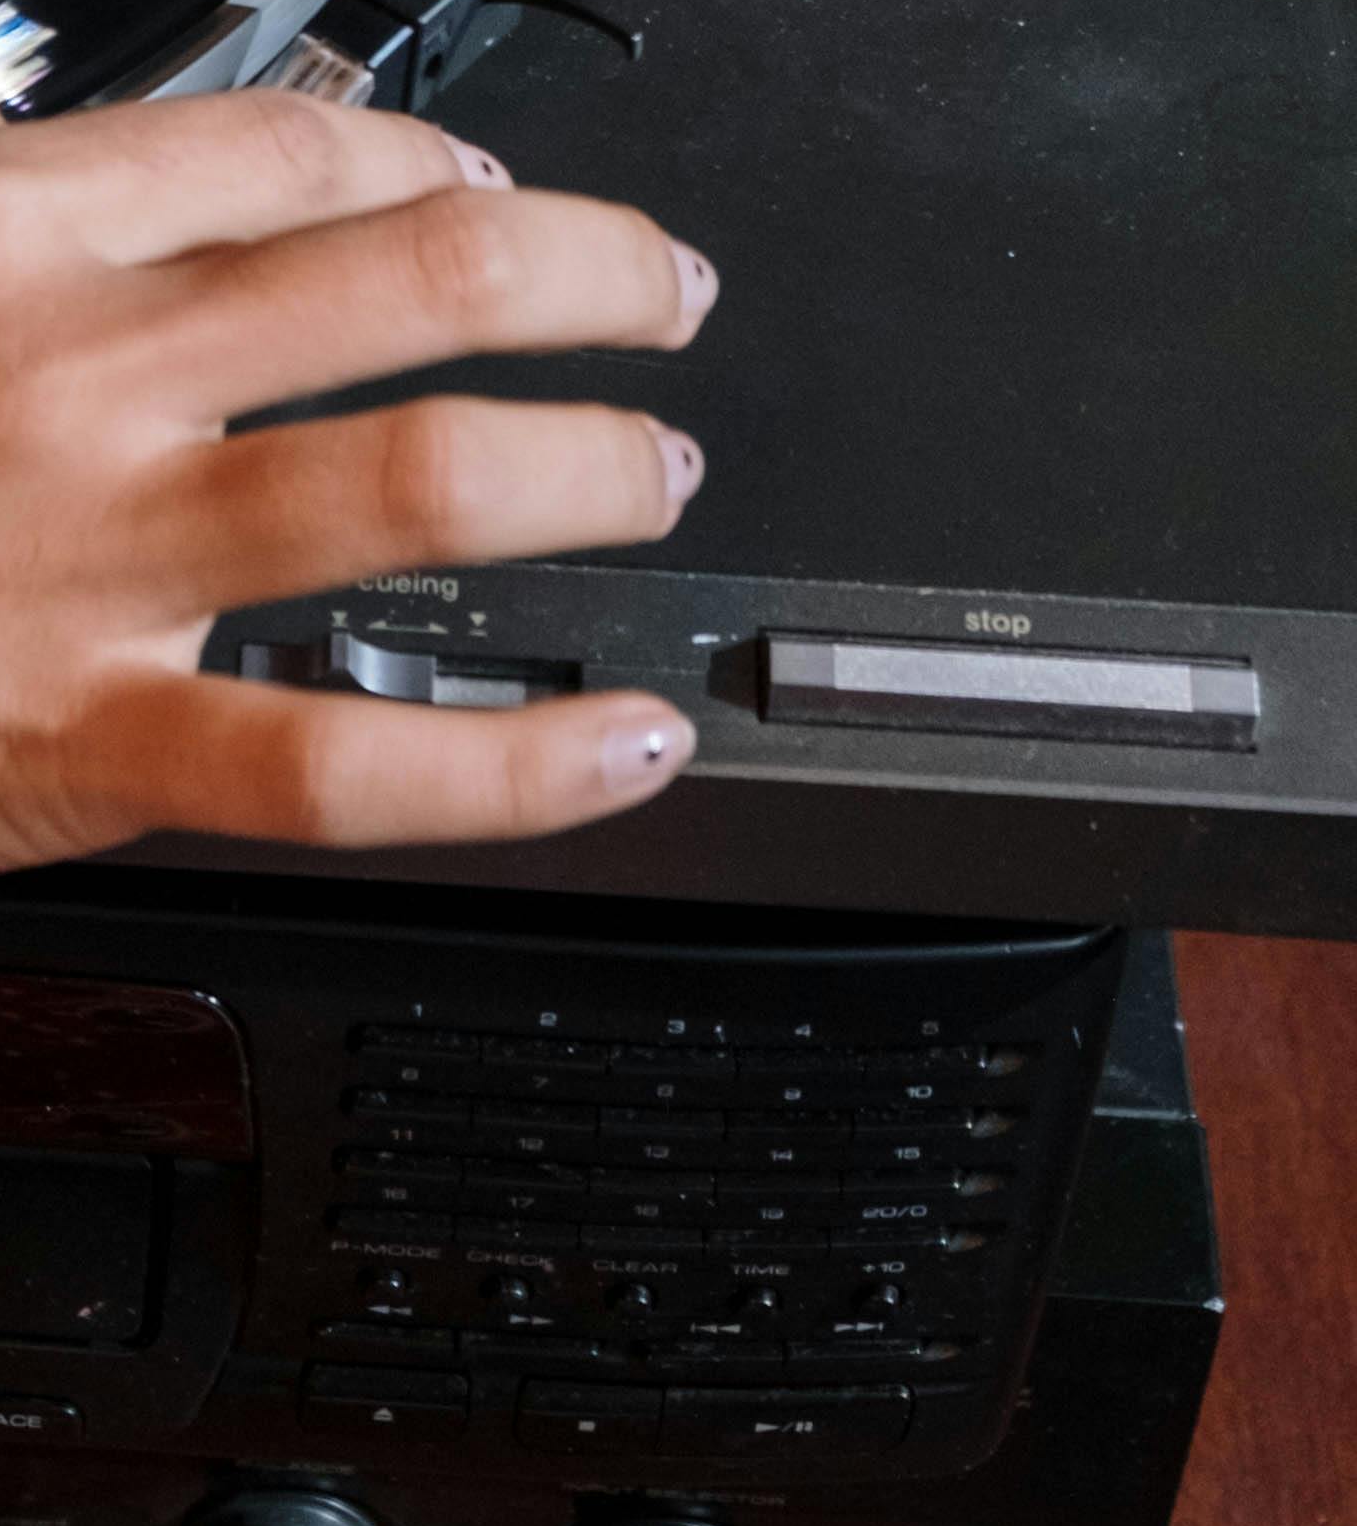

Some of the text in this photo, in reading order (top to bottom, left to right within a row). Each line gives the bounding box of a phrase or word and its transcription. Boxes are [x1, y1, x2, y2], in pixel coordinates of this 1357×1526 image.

[358, 575, 460, 602] cueing
[965, 609, 1032, 638] stop
[465, 1250, 554, 1268] CHECK
[592, 1259, 680, 1274] CLEAR
[730, 1264, 791, 1277] TIME
